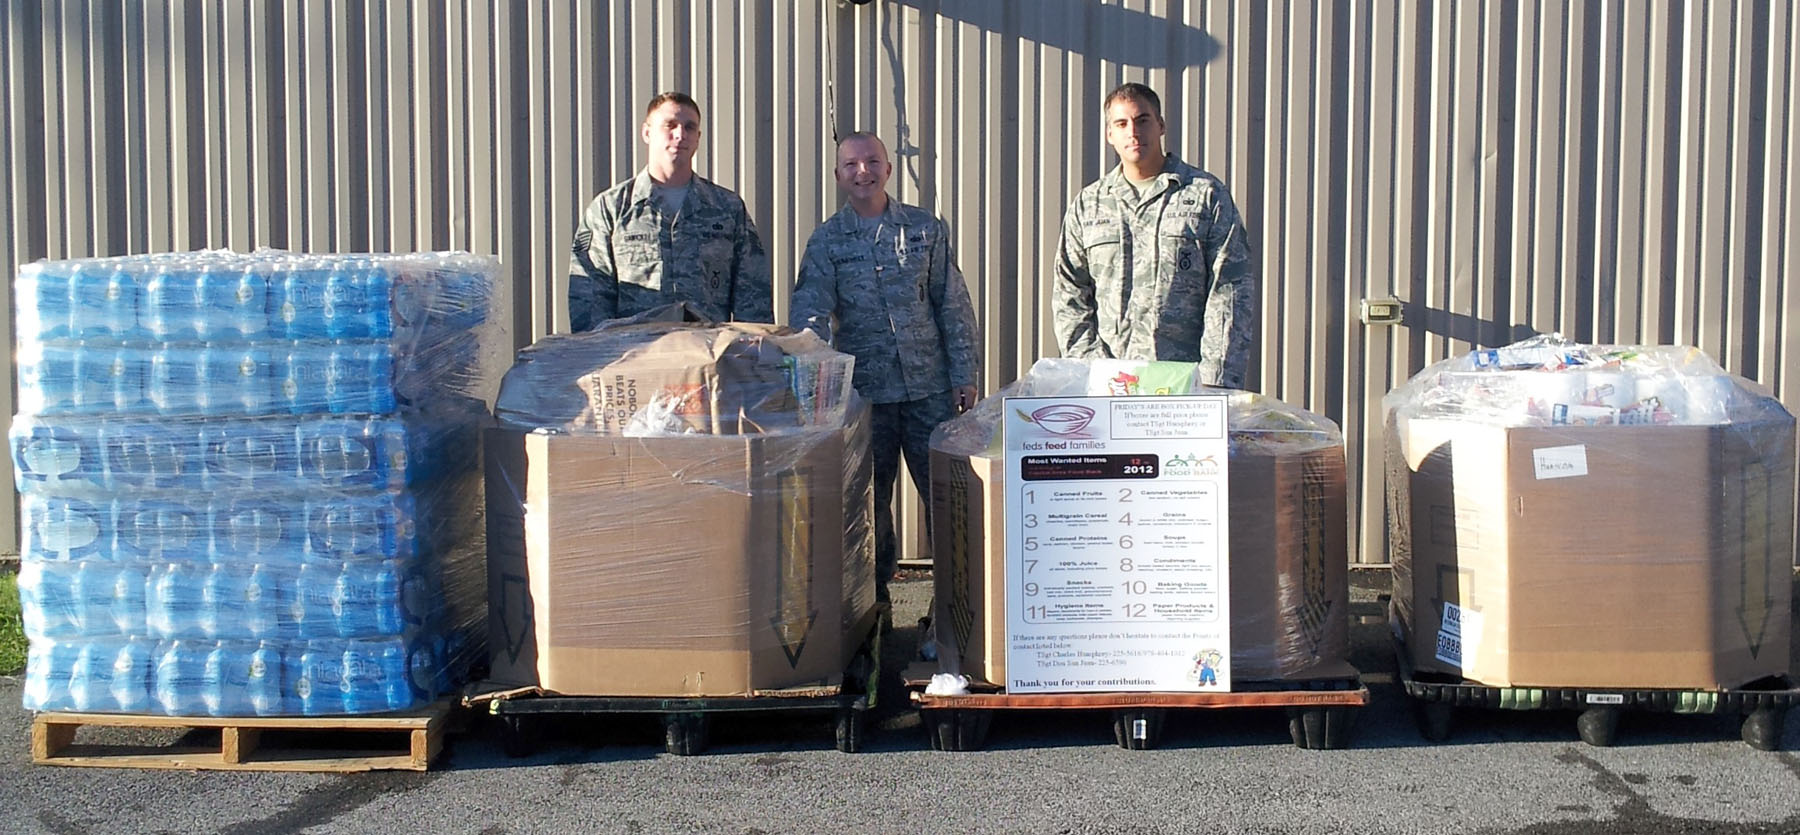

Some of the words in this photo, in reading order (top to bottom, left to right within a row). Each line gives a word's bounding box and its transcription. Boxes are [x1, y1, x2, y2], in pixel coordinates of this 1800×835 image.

[616, 375, 626, 406] BEATS
[1022, 442, 1042, 450] feds
[1045, 442, 1067, 450] feed
[1069, 441, 1106, 449] families
[1123, 465, 1154, 474] 2012
[1025, 490, 1035, 504] 1
[1118, 488, 1133, 502] 2
[1025, 513, 1038, 528] 3
[1118, 512, 1133, 526] 4
[1025, 537, 1039, 551] 5
[1119, 535, 1133, 549] 6
[1025, 559, 1038, 574] 7
[1119, 558, 1133, 572] 8
[1025, 582, 1039, 597] 9
[1121, 580, 1147, 595] 10
[1026, 605, 1046, 619] 11
[1121, 603, 1147, 618] 12
[1014, 679, 1041, 687] Thank
[1061, 678, 1074, 686] for
[1075, 680, 1095, 688] your
[1097, 678, 1157, 686] contributions.
